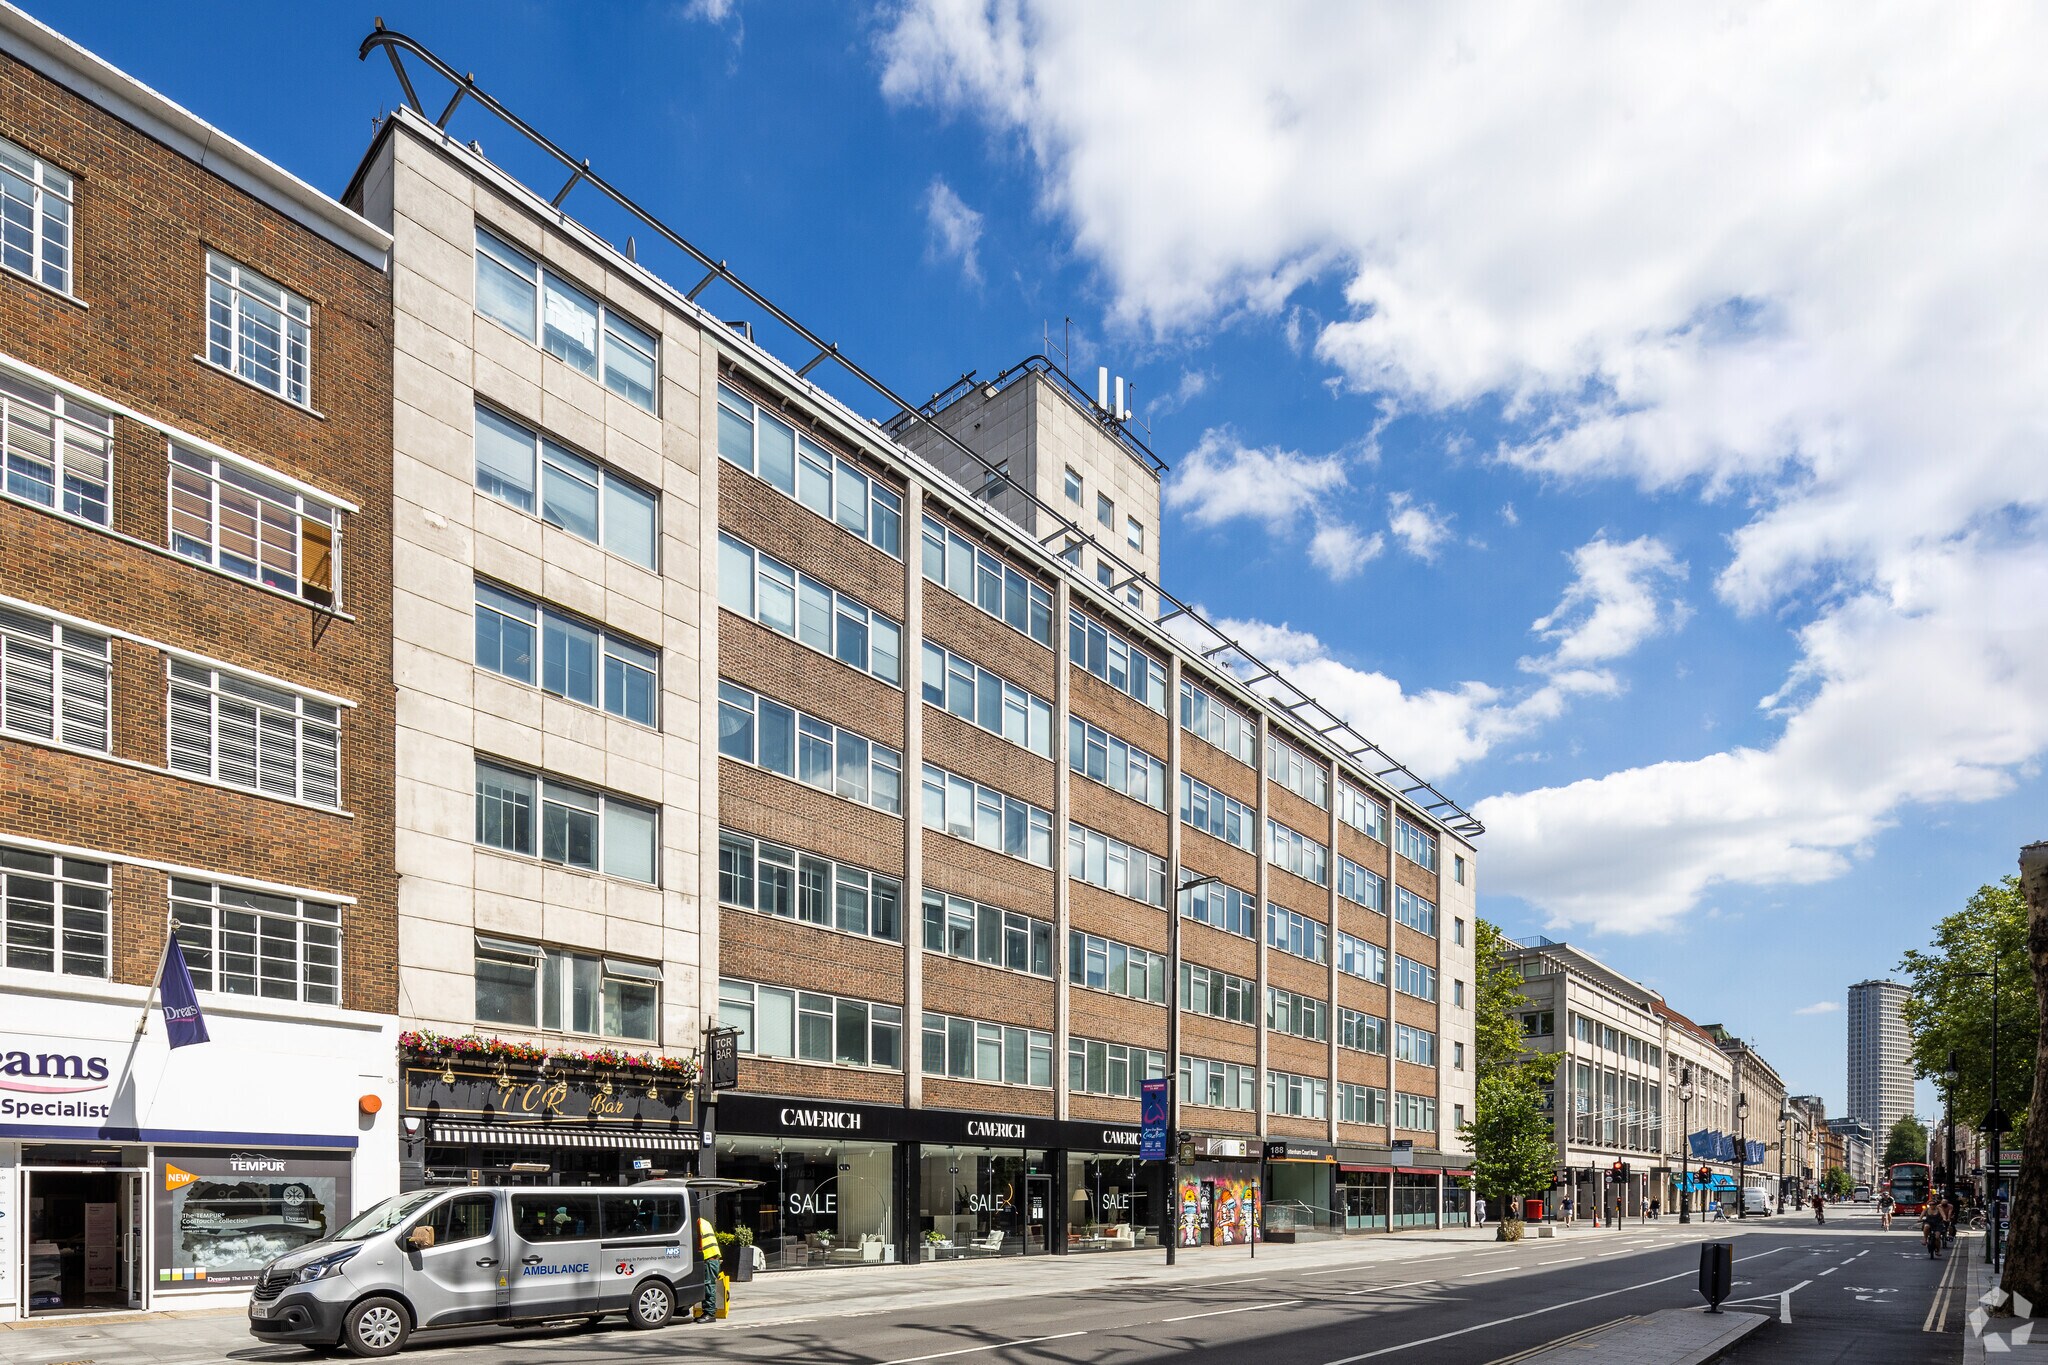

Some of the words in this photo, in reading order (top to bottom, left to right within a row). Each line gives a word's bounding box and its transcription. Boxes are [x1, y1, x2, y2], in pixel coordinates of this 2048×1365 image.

[715, 1037, 732, 1049] TCR
[716, 1048, 732, 1061] BAR
[1, 1098, 109, 1119] Specialist
[589, 1093, 625, 1115] Bar
[781, 1108, 861, 1130] CAMERICH
[967, 1120, 1025, 1139] CAMERICH
[1103, 1130, 1142, 1145] CAMERIC
[1270, 1146, 1284, 1154] 188
[230, 1160, 286, 1172] TEMPUR
[167, 1173, 191, 1183] NEW
[789, 1193, 837, 1214] SALE
[969, 1193, 1004, 1212] SALE
[1102, 1193, 1130, 1210] SALE
[666, 1248, 680, 1256] NHS
[523, 1263, 589, 1276] AMBULANCE
[615, 1262, 635, 1276] G4S
